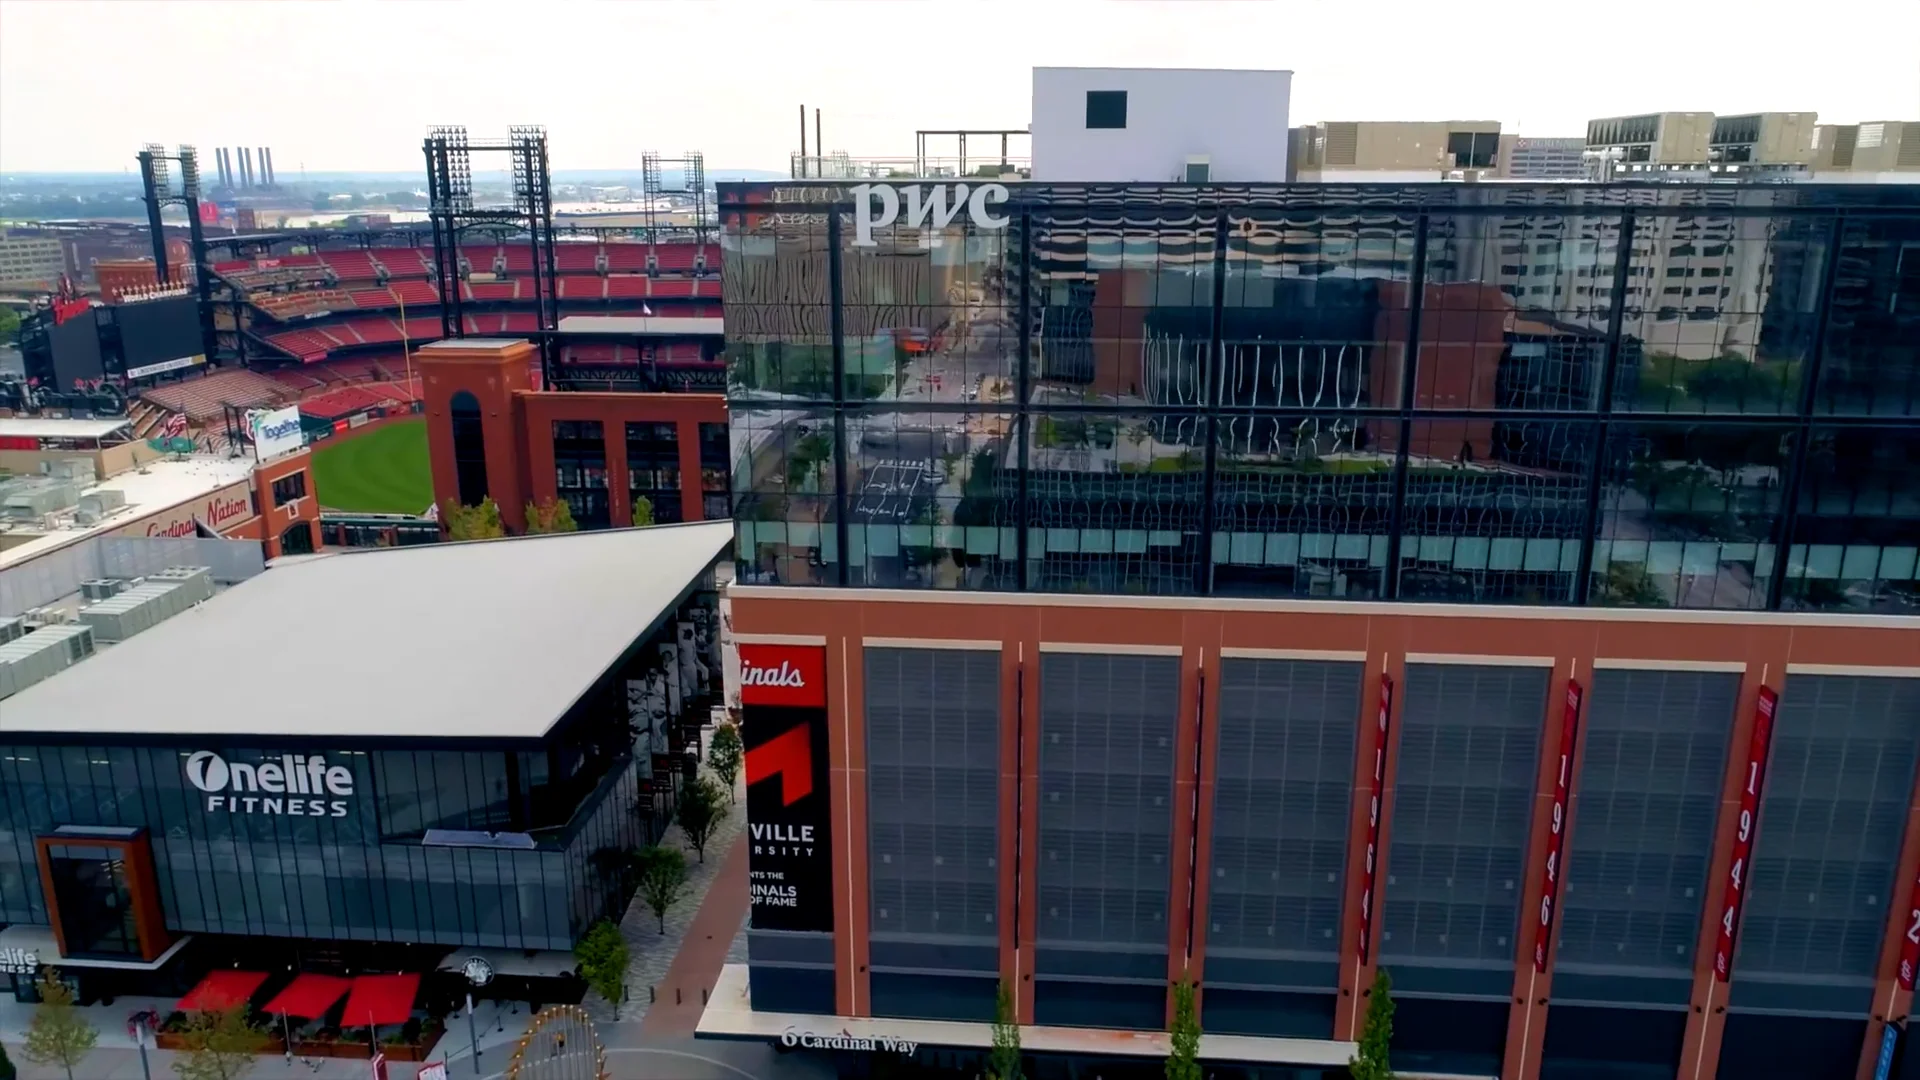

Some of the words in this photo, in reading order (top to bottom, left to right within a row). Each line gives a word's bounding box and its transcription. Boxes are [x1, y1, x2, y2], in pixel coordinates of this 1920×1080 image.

[850, 183, 1010, 246] pwc
[262, 419, 300, 440] Togethe
[146, 512, 197, 537] Crdinal
[207, 498, 247, 526] Nation
[208, 796, 347, 817] FITNESS
[1540, 754, 1567, 925] 1946
[1723, 762, 1757, 937] 1944
[766, 872, 784, 880] THE
[750, 884, 797, 897] INALS
[766, 897, 797, 907] FAME
[782, 1026, 798, 1047] 6
[800, 1032, 878, 1051] Cardinal
[881, 1036, 918, 1057] Way
